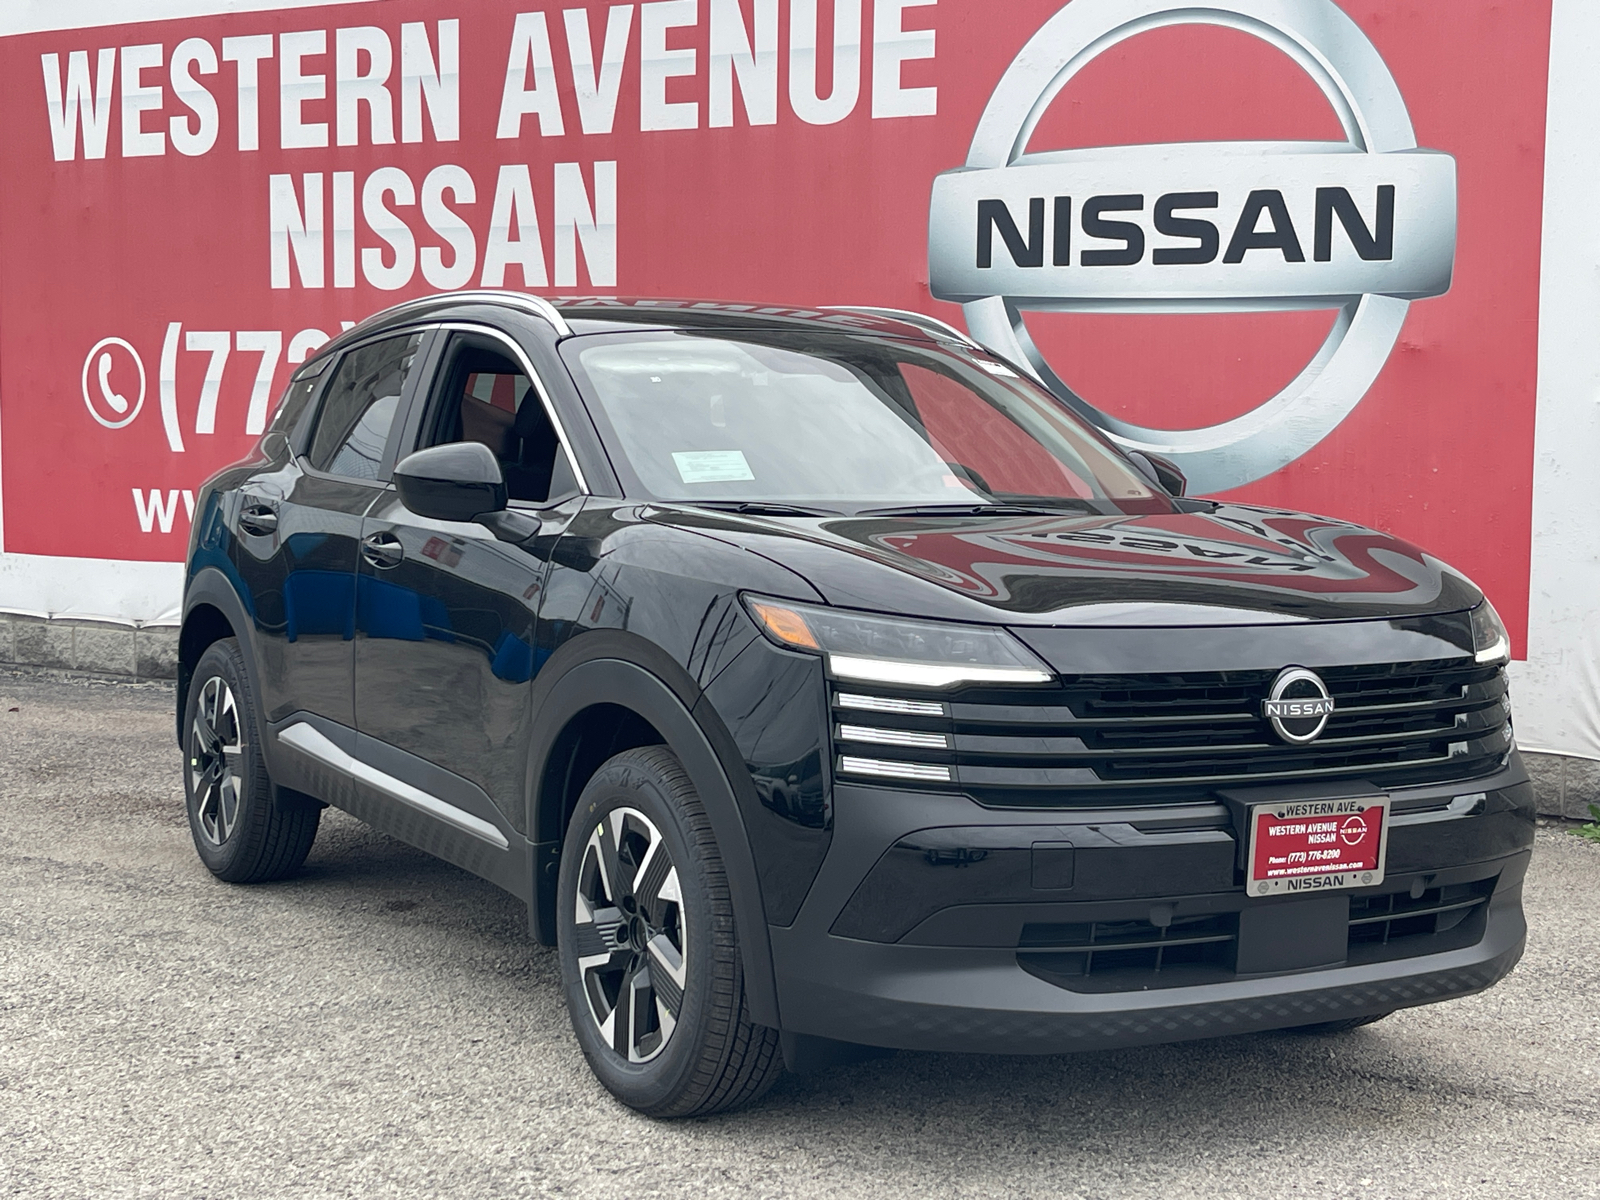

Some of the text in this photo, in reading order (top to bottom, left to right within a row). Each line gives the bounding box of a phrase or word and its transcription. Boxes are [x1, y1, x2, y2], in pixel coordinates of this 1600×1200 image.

[41, 0, 938, 162] WESTERN AVENUE
[269, 160, 617, 290] NISSAN
[976, 184, 1395, 268] NISSAN
[160, 321, 356, 452] (77
[1267, 701, 1334, 716] NISSAN
[1286, 803, 1334, 816] WESTERN
[1269, 822, 1337, 836] WESTERN AVENUE
[1308, 833, 1336, 844] NISSAN
[1268, 849, 1341, 864] Phone: (773) 776-8200
[1267, 862, 1363, 876] www.westernavenissan.com
[1287, 874, 1344, 890] NISSAN
